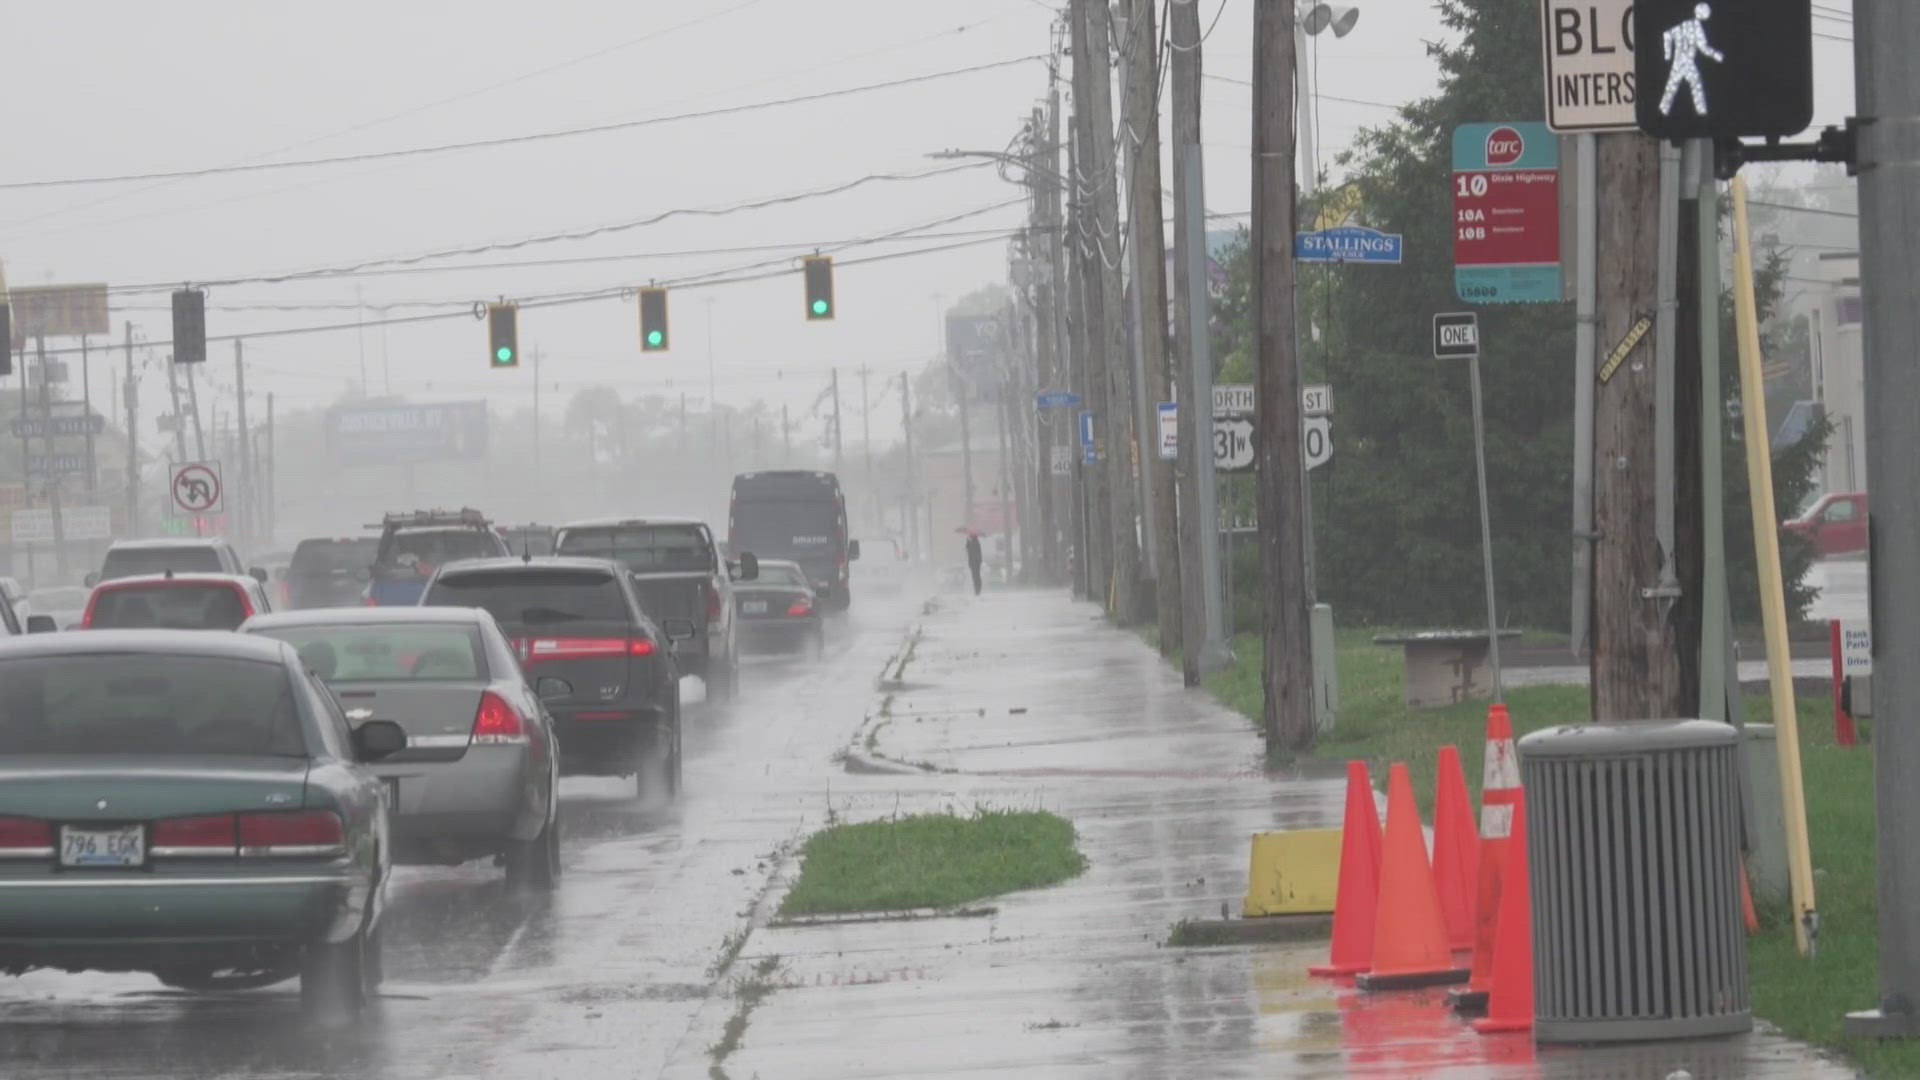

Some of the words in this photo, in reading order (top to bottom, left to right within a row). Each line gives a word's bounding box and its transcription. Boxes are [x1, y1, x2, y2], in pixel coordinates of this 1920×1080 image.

[1557, 72, 1634, 107] INTERS
[1489, 139, 1519, 155] tarc
[1457, 175, 1488, 197] 10
[1492, 174, 1513, 183] Dixie
[1515, 173, 1555, 184] Highway
[1457, 209, 1485, 222] 10A
[1458, 227, 1486, 240] 10B
[1303, 236, 1394, 252] STALLINGS
[1444, 327, 1470, 343] ONE
[792, 535, 828, 545] amazon
[65, 834, 97, 854] 796
